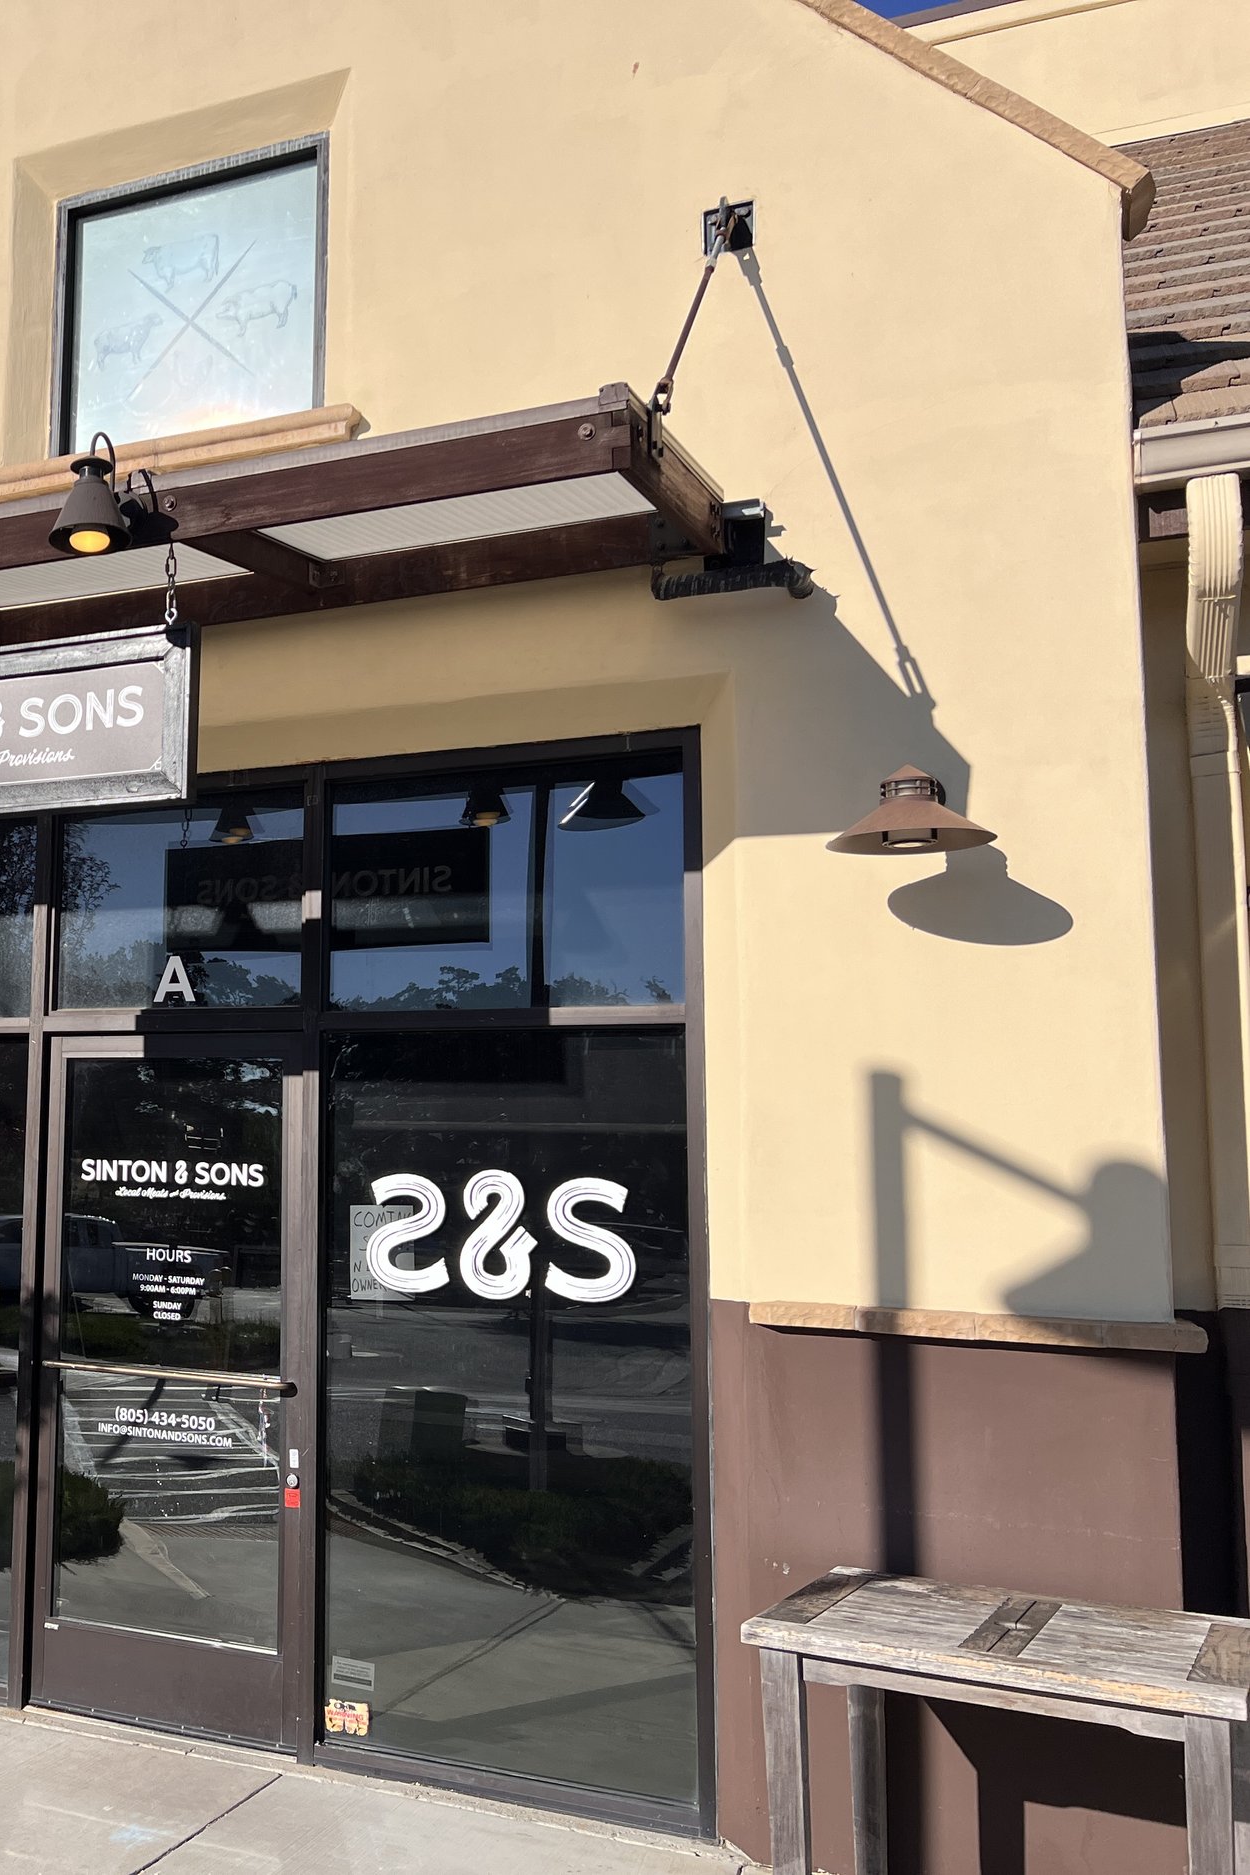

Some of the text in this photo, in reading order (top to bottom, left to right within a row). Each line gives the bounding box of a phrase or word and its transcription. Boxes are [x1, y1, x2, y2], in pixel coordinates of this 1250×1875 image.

[18, 685, 144, 738] SONS
[153, 955, 196, 1003] A
[80, 1158, 265, 1188] SINTON & SONS
[114, 1186, 140, 1198] Local
[141, 1187, 169, 1200] Meats
[179, 1188, 227, 1201] Provisions
[353, 1210, 412, 1228] COMI
[146, 1247, 192, 1264] HOURS
[132, 1272, 164, 1283] MONDAY
[167, 1275, 206, 1287] SATURDAY
[139, 1283, 166, 1293] 9:00AM
[170, 1286, 196, 1296] 6:00PM
[152, 1300, 182, 1311] SUNDAY
[152, 1310, 181, 1321] CLOSED
[115, 1405, 216, 1431] (805) 434-5050
[97, 1422, 233, 1448] INFO@SINTONANDSONS.COM
